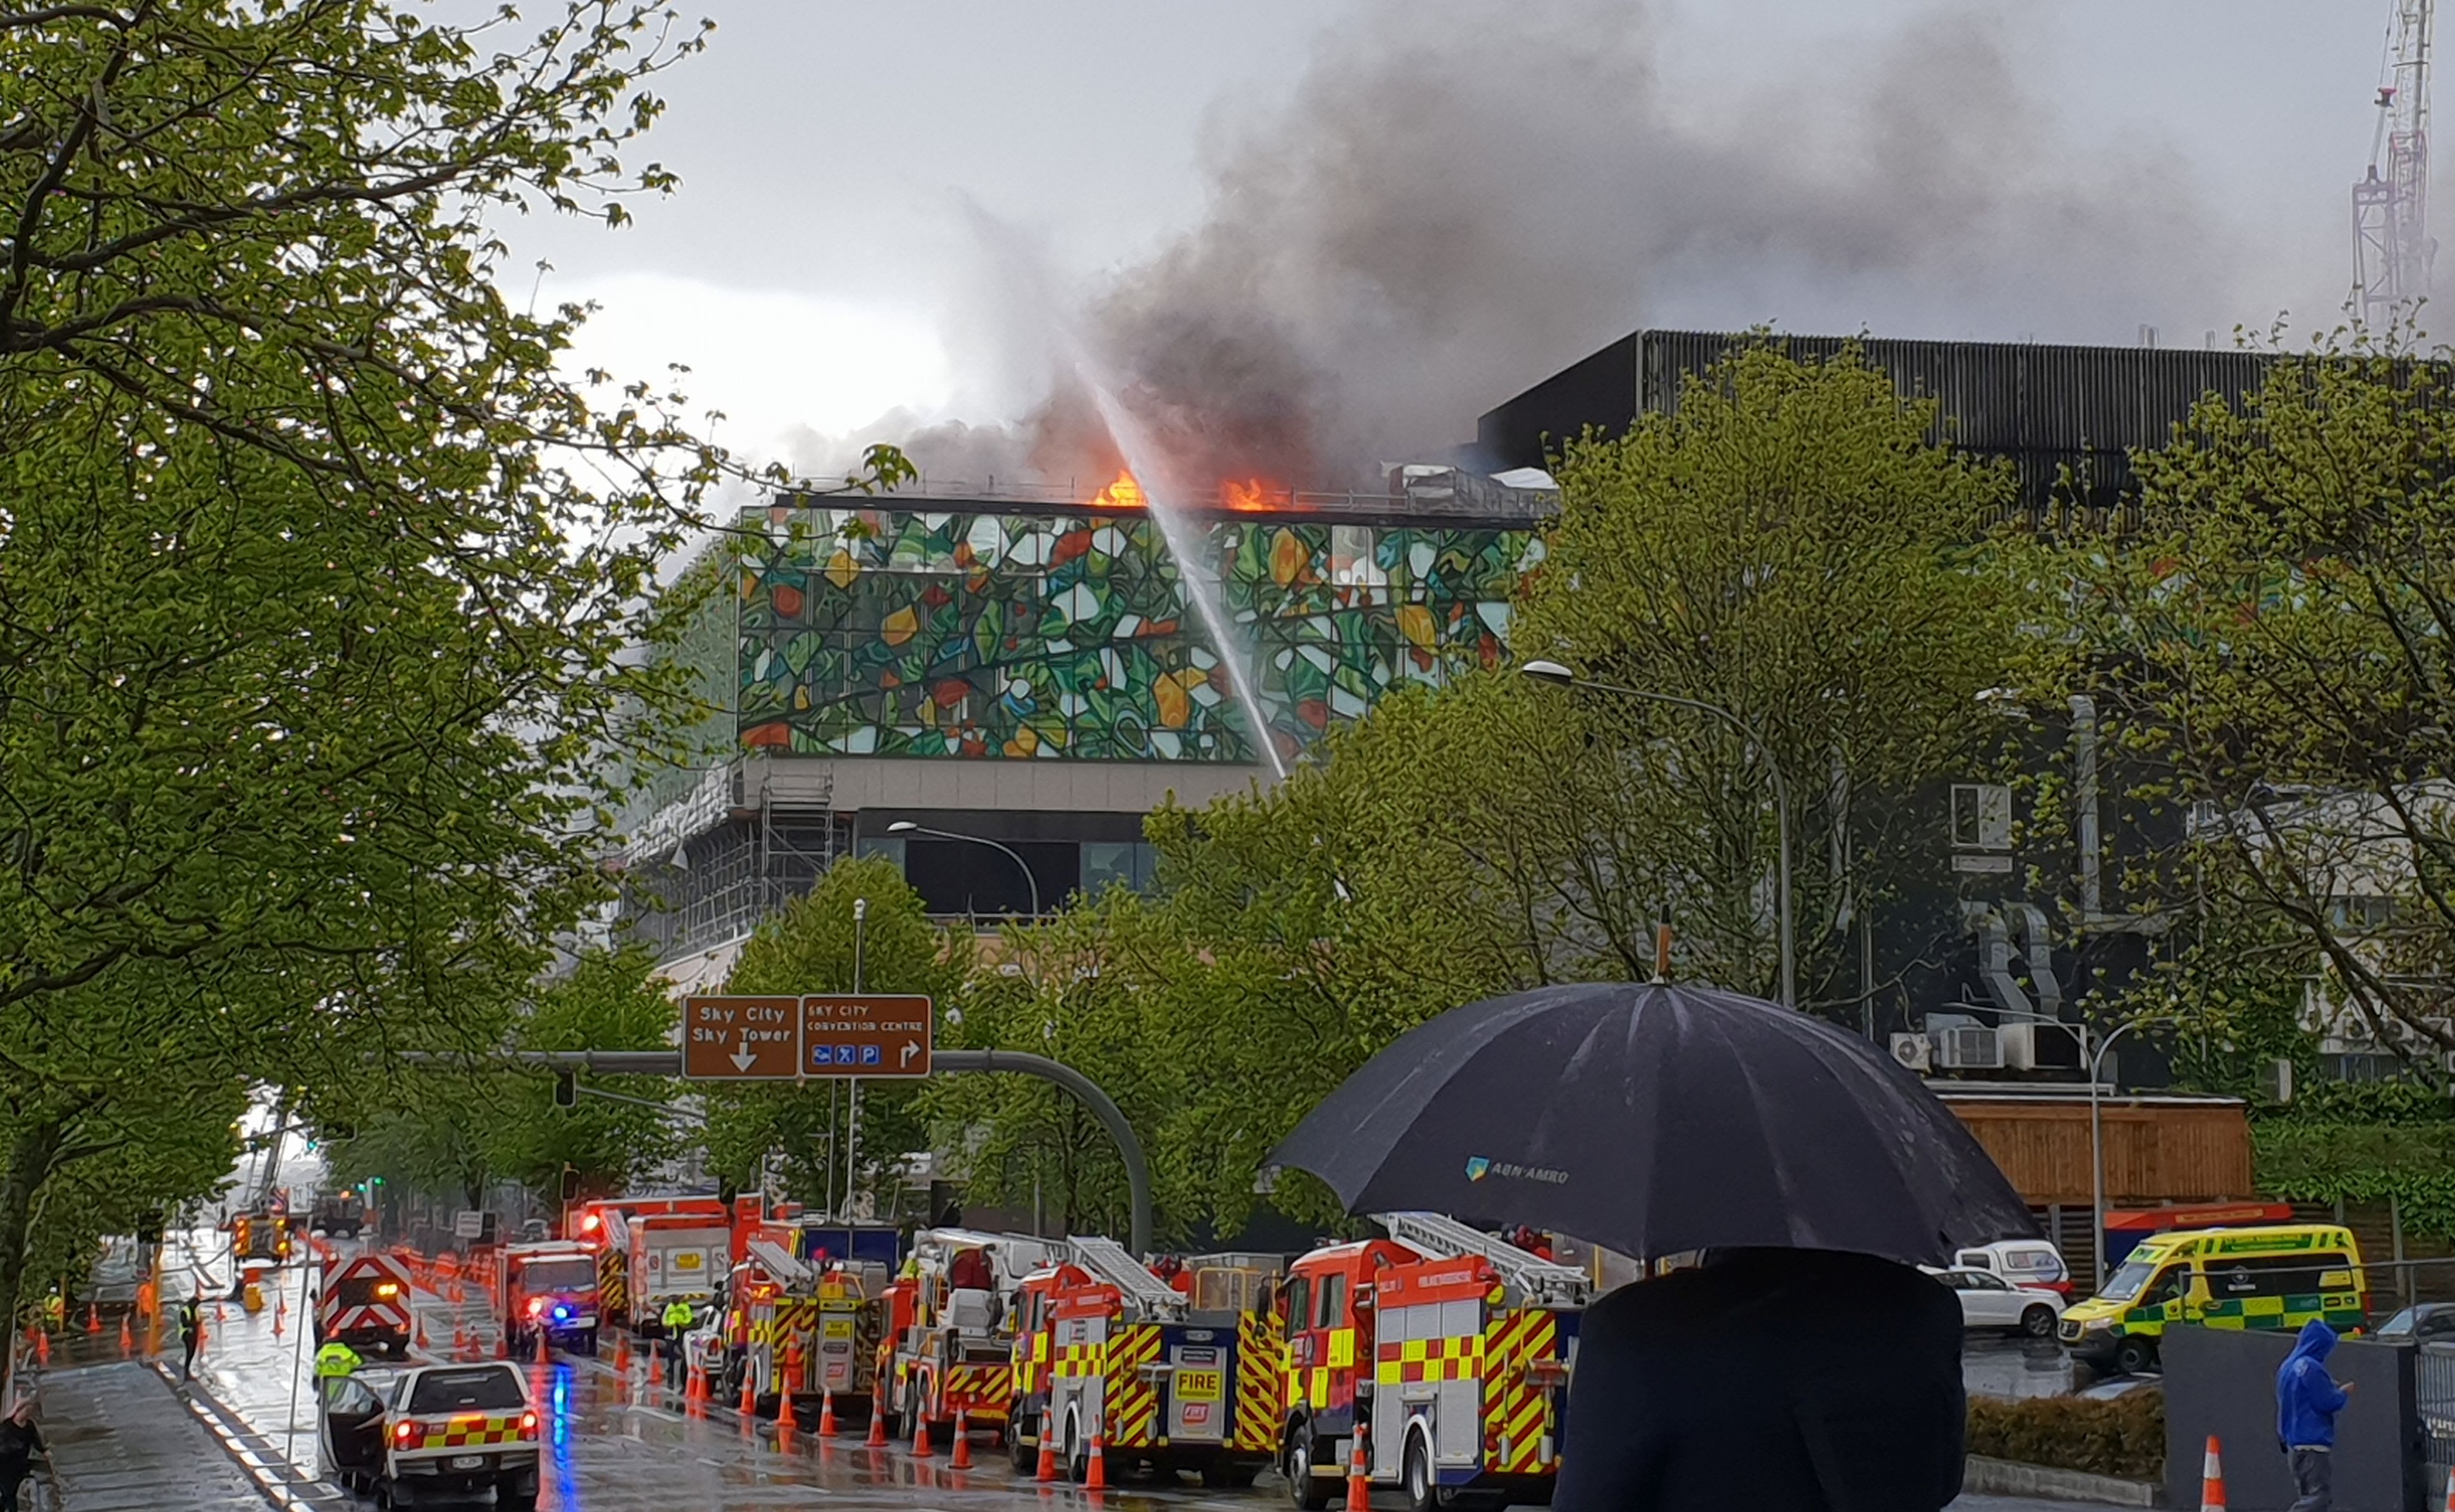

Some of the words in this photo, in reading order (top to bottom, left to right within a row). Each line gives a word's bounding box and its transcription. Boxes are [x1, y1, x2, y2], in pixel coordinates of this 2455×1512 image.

[700, 1007, 735, 1024] Sky
[746, 1007, 784, 1024] City
[808, 1005, 832, 1017] SKY
[839, 1005, 869, 1017] CITY
[880, 1021, 923, 1032] CENTRE
[692, 1027, 727, 1044] Sky
[739, 1027, 791, 1041] Tower
[1178, 1373, 1217, 1390] FIRE
